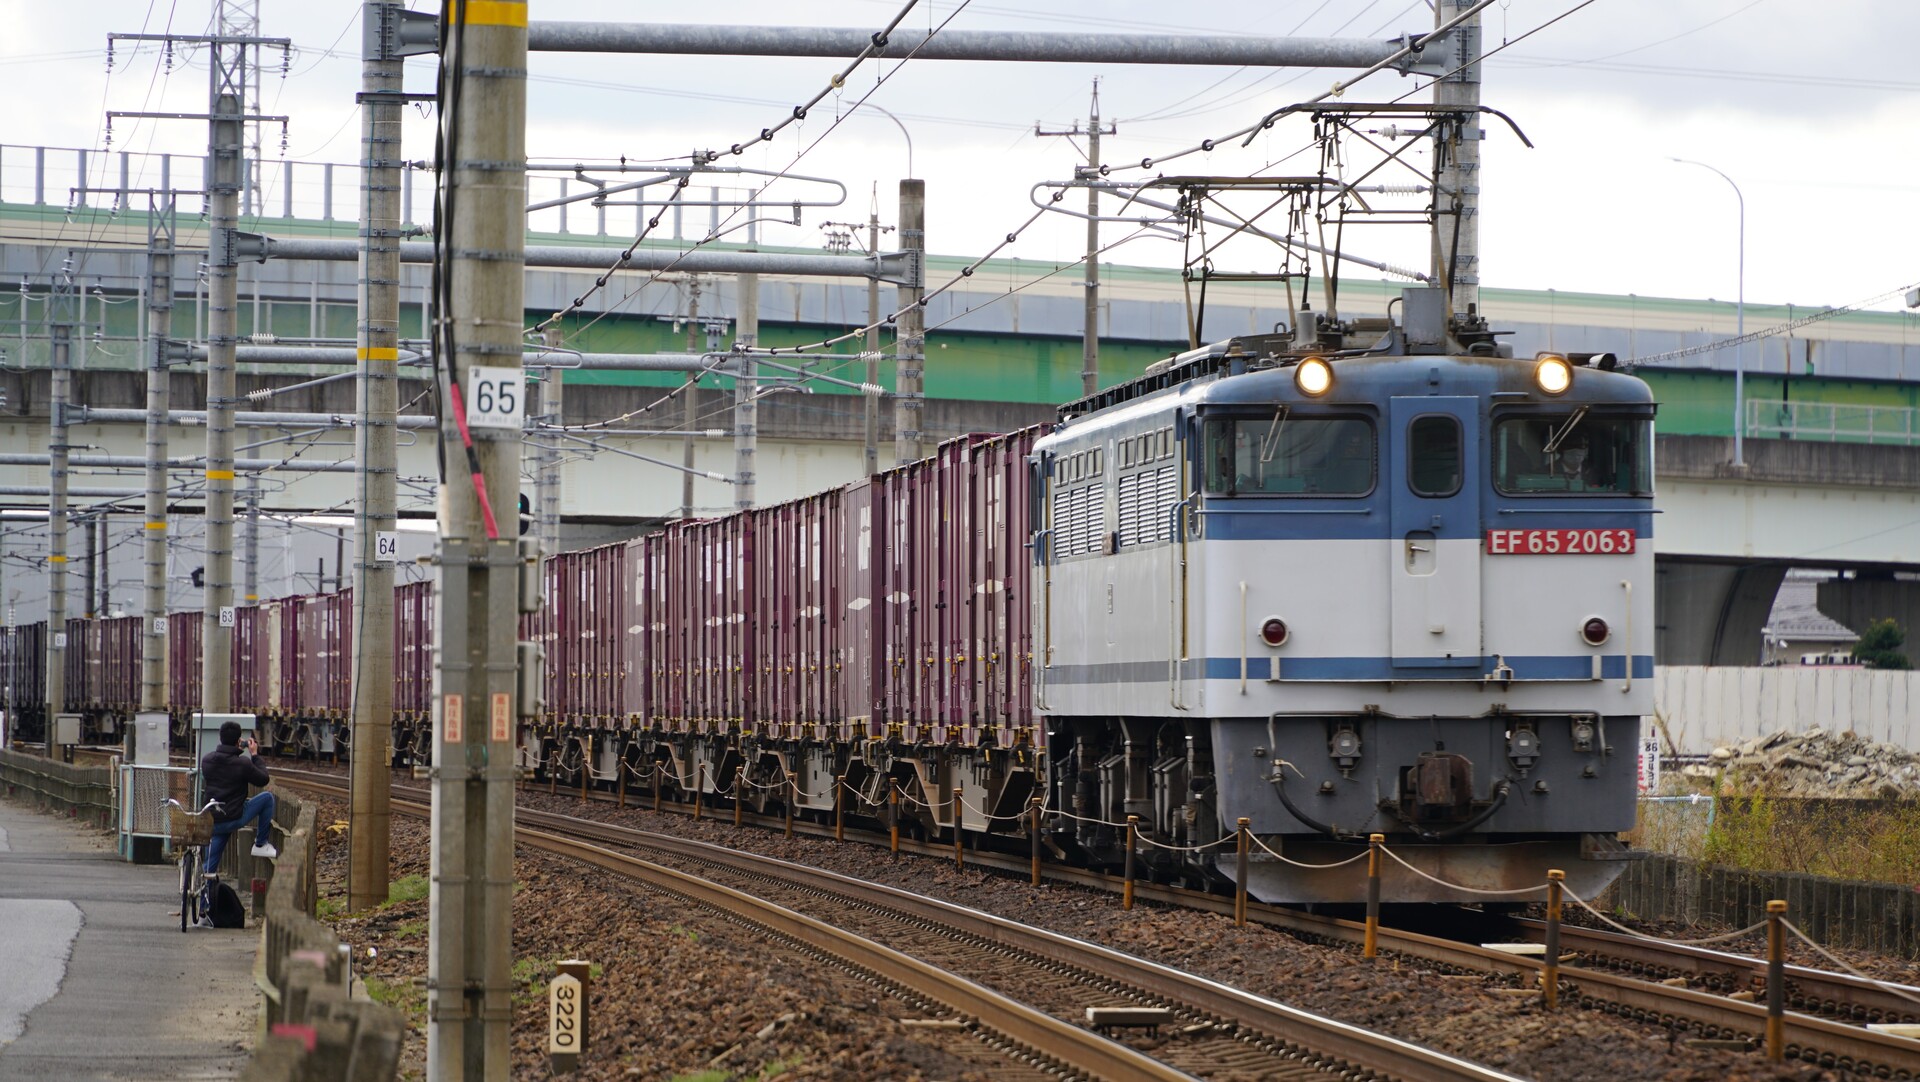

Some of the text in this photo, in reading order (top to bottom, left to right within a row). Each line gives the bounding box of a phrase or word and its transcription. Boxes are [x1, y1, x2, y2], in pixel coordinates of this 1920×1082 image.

[477, 380, 515, 414] 65
[379, 537, 395, 555] 64
[1491, 530, 1631, 553] EF 65 2063
[155, 620, 165, 631] 62
[221, 610, 233, 623] 63
[556, 986, 575, 1046] 3220
